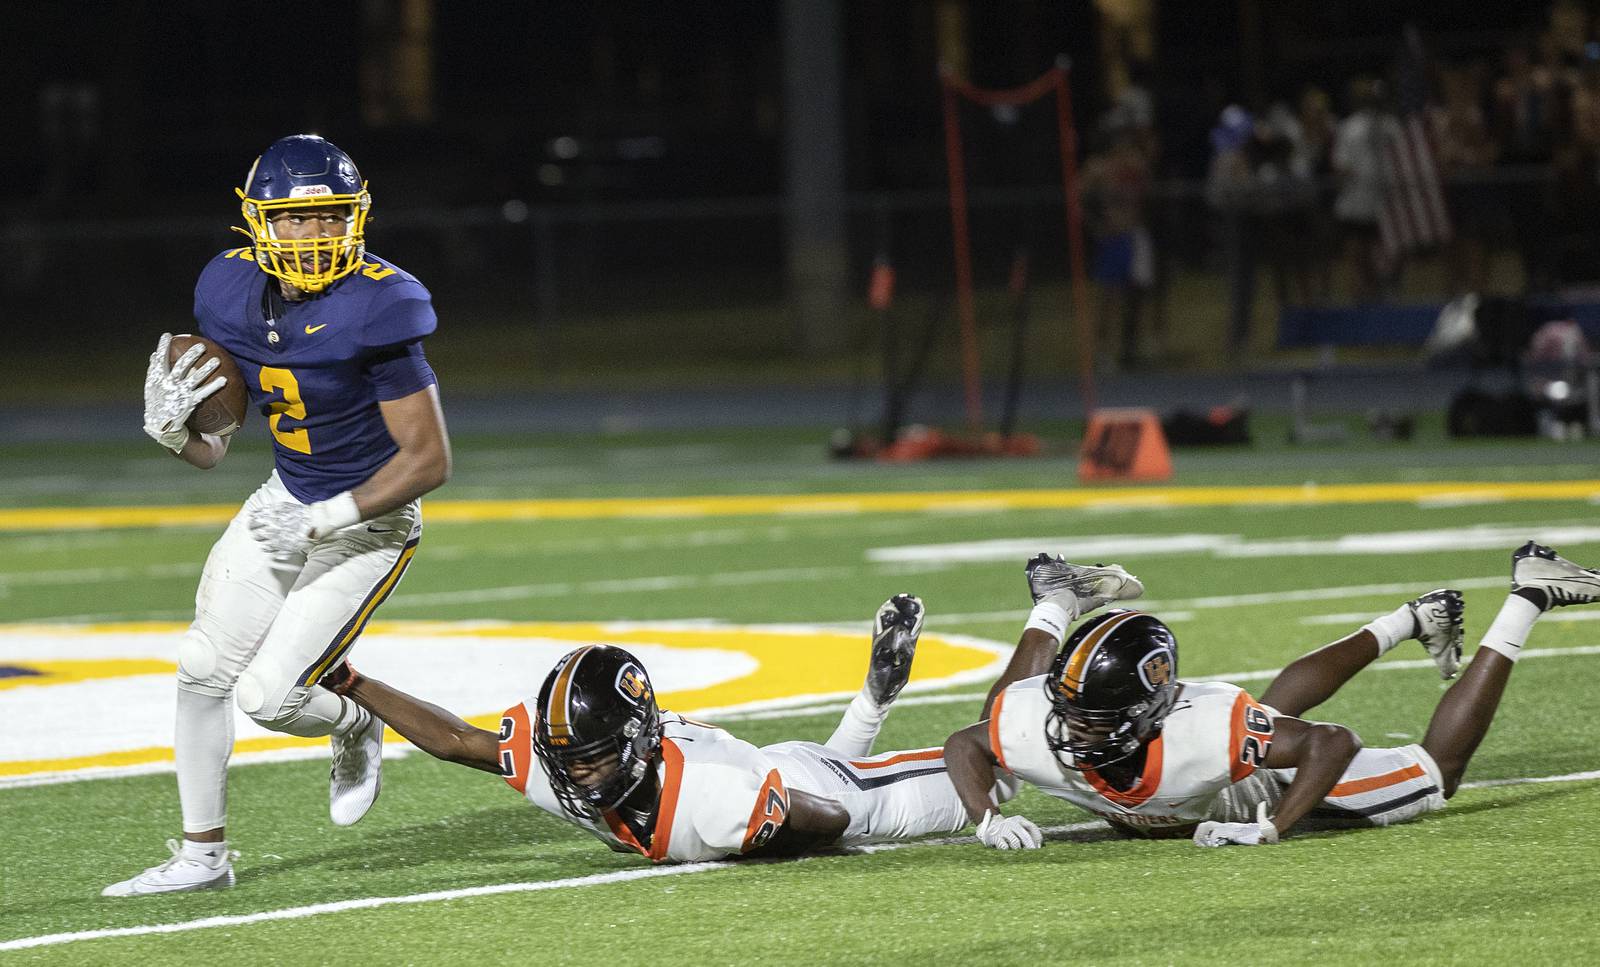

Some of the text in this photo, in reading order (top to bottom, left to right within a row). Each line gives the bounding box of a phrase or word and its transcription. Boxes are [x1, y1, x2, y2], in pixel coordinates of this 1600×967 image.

[258, 366, 313, 456] 2
[1240, 704, 1275, 768] 26
[820, 757, 850, 786] PANTHERS
